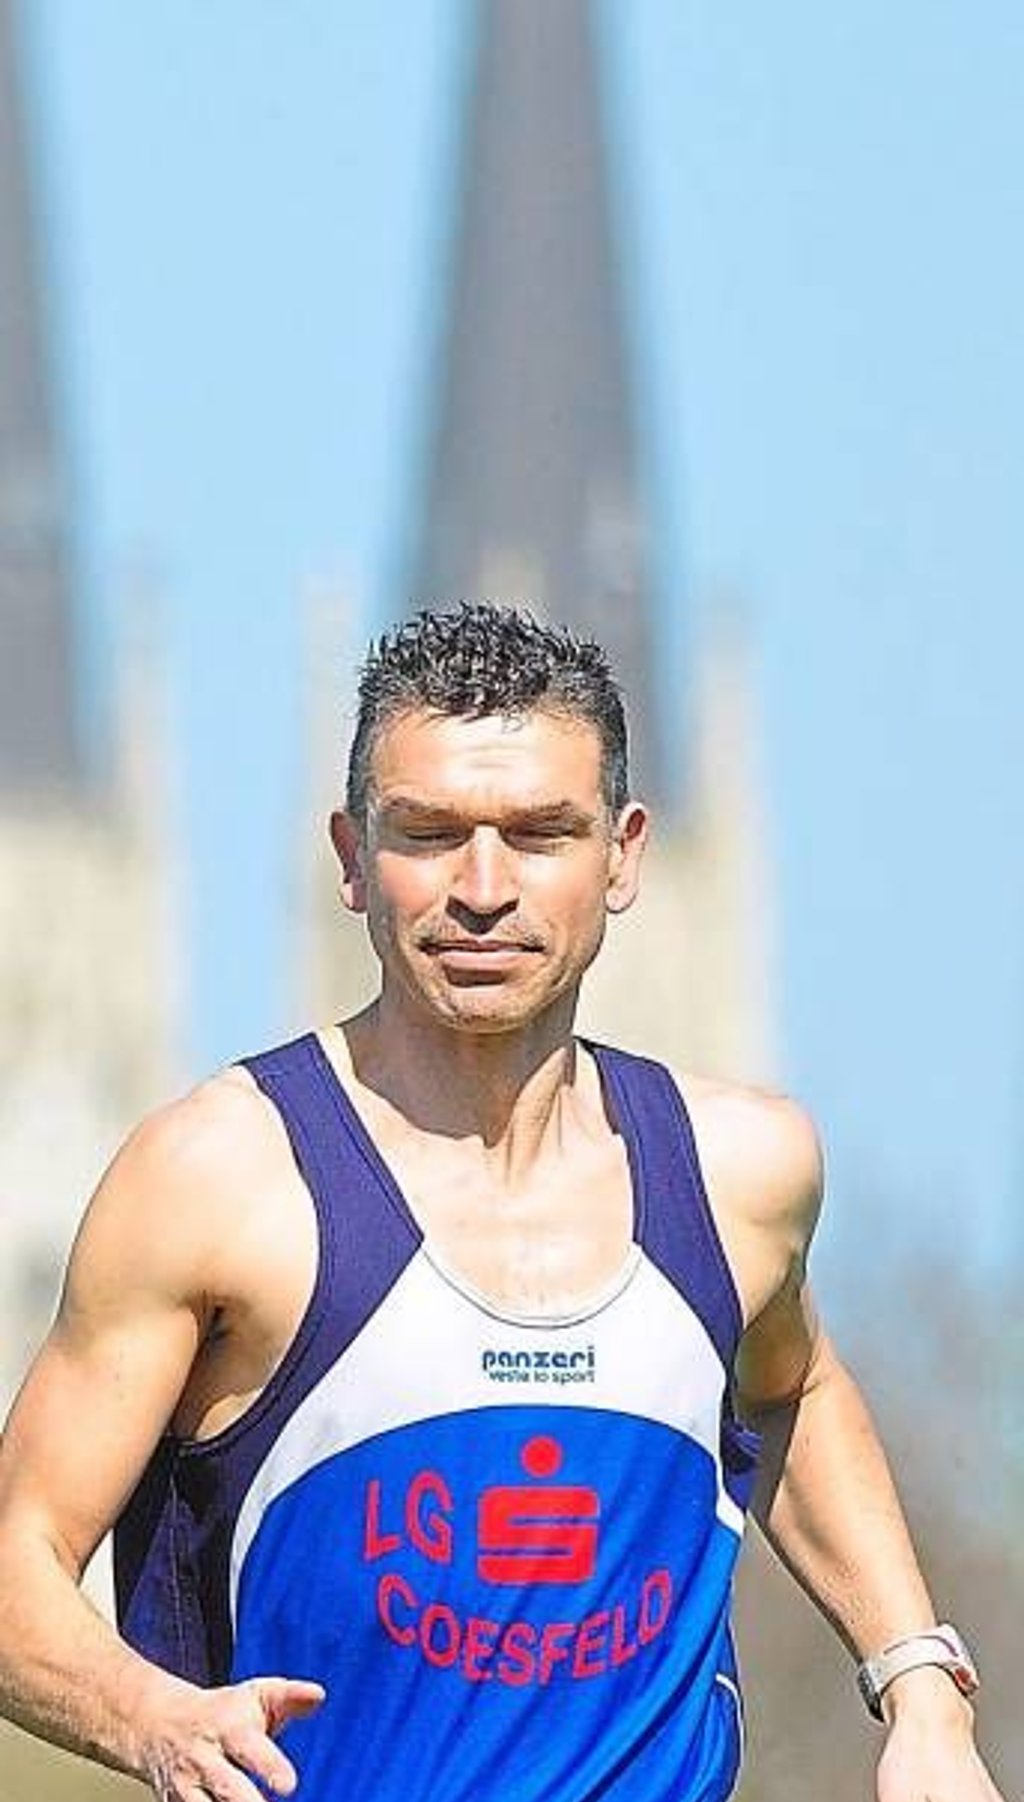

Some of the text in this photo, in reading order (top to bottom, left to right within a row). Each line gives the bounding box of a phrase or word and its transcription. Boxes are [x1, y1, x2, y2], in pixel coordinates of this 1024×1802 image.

[482, 1345, 595, 1371] panzeri
[364, 1470, 453, 1565] LG
[377, 1569, 673, 1687] COESFELD
